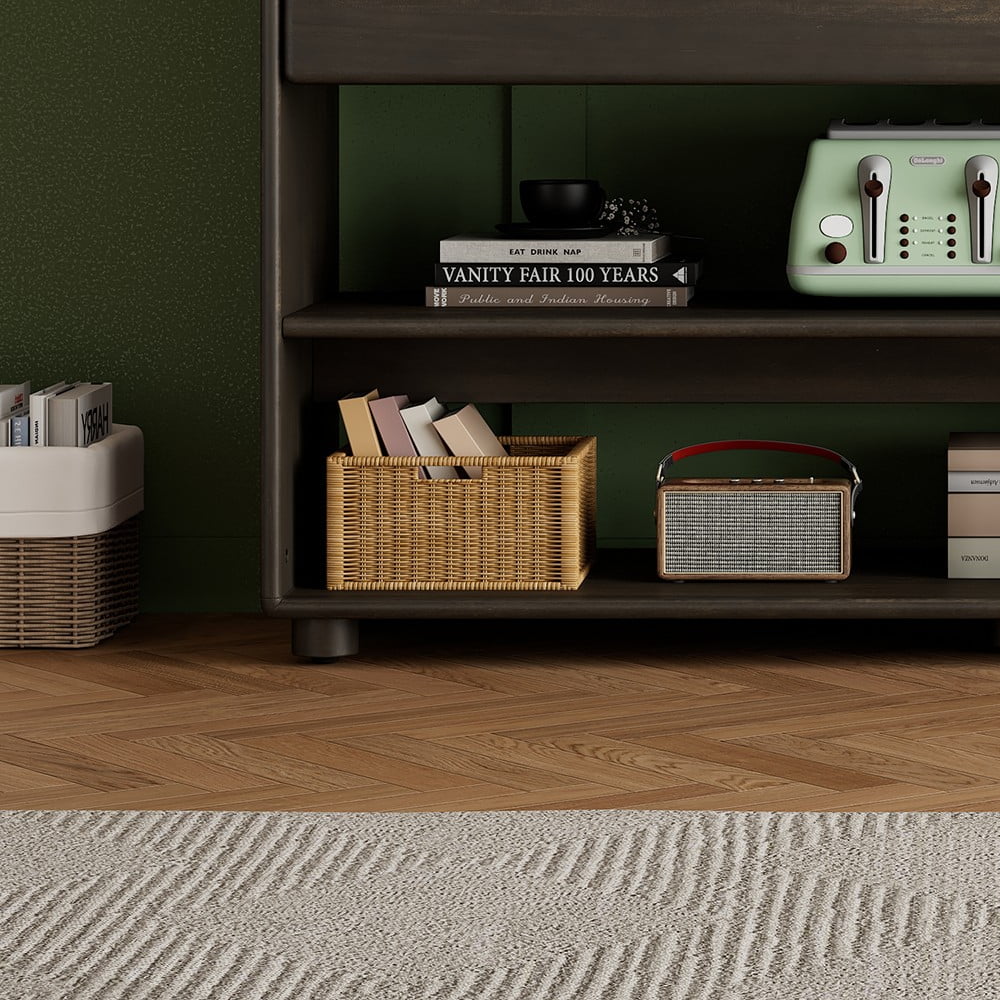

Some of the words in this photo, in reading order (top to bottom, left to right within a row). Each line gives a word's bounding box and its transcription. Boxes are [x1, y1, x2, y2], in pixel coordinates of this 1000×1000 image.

[530, 248, 558, 256] DRINK
[563, 248, 582, 256] NAP
[442, 266, 514, 283] VANITY
[520, 266, 561, 283] FAIR
[567, 266, 595, 283] 100
[601, 266, 659, 283] YEARS
[458, 294, 501, 305] Public
[506, 294, 534, 305] and
[539, 294, 588, 305] Indian
[593, 294, 651, 307] Housing
